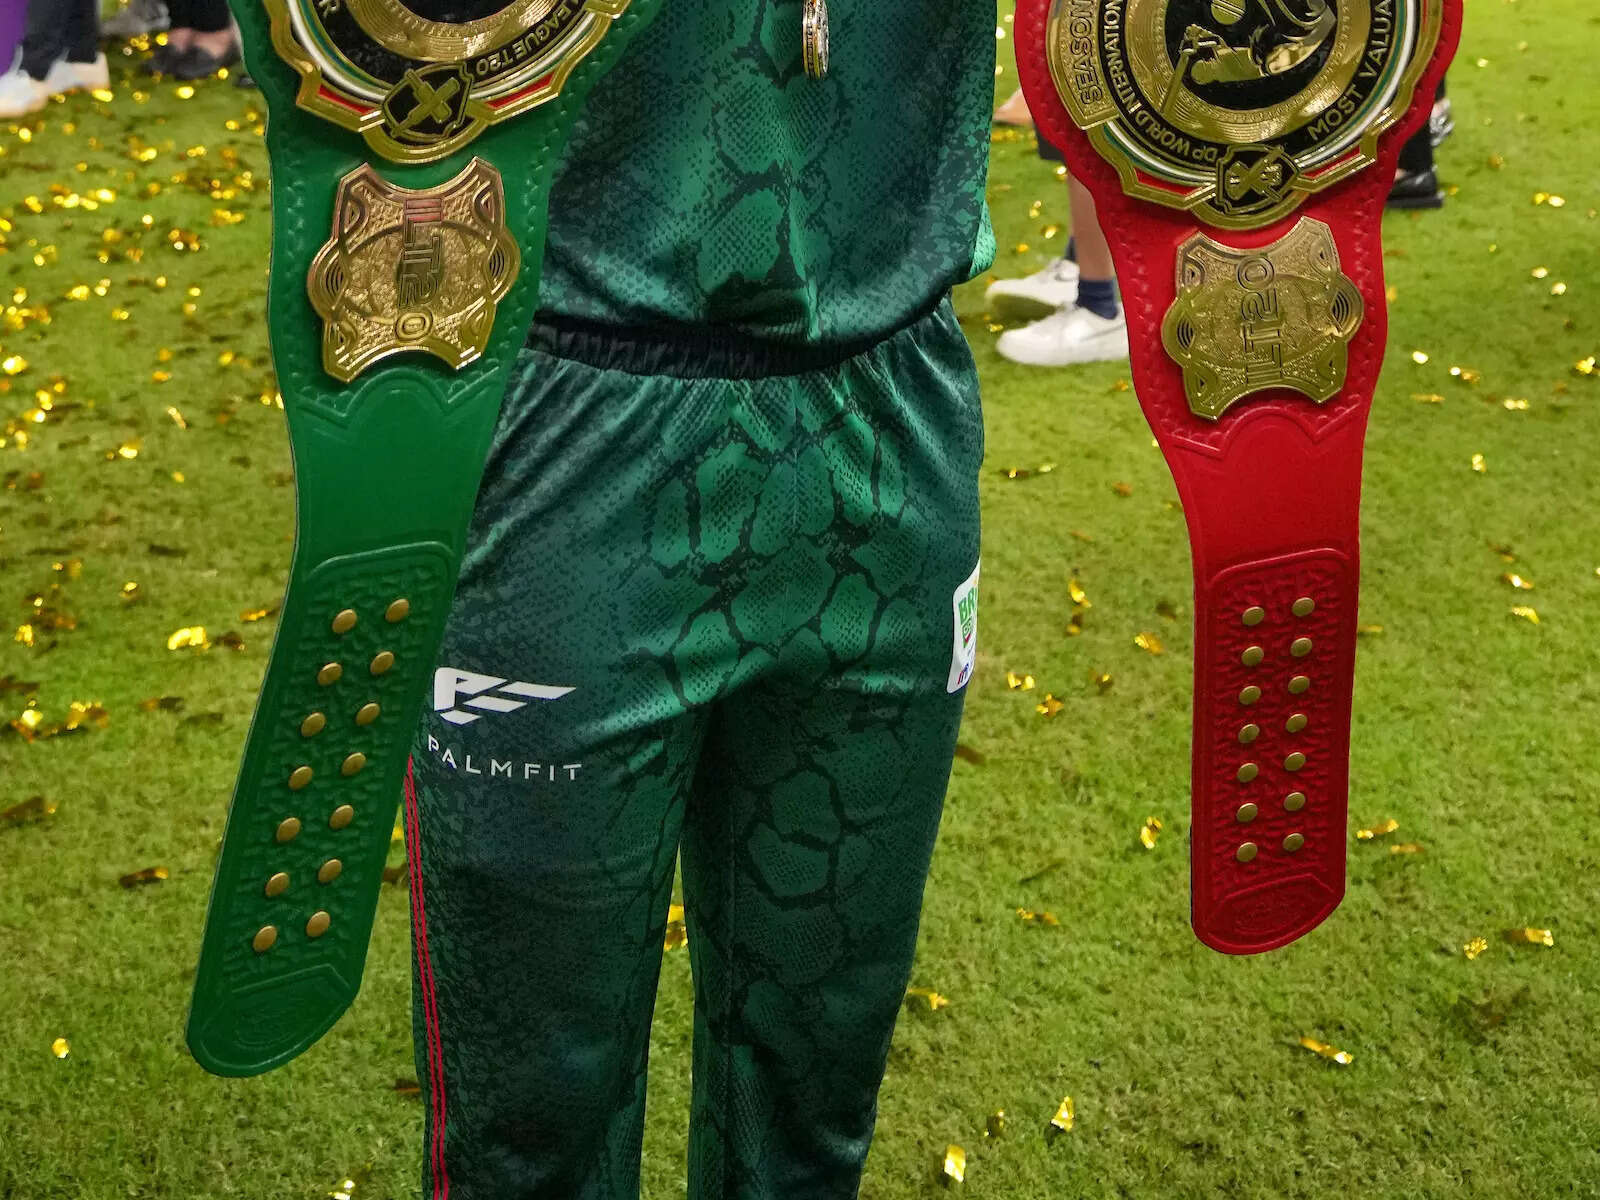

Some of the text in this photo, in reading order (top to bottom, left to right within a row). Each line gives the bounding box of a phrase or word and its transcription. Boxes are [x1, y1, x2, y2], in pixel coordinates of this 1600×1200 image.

[475, 50, 514, 76] T20
[1135, 110, 1191, 156] WORLD
[1307, 83, 1365, 141] MOST
[428, 733, 582, 782] PALMFIT
